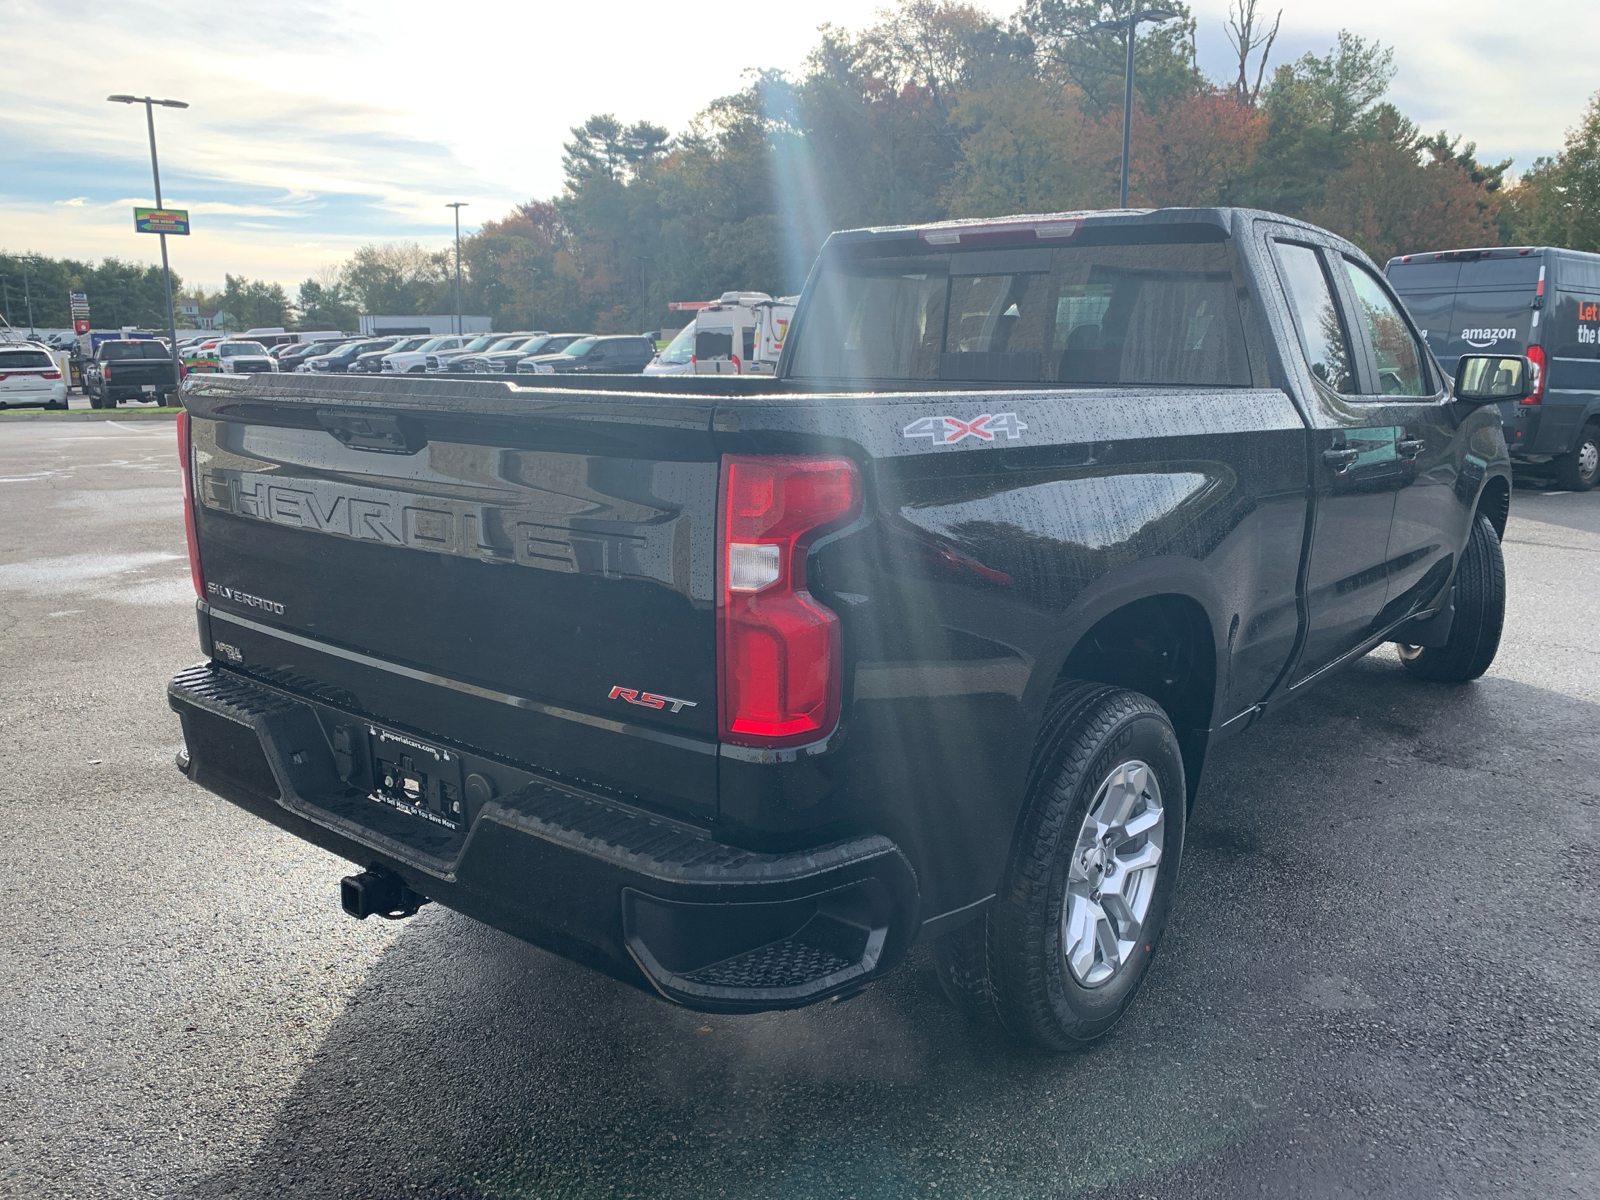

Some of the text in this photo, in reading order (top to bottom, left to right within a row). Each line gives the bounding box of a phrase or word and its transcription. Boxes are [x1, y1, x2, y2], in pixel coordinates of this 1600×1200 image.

[1579, 301, 1597, 321] Let
[1461, 328, 1517, 340] amazon
[1578, 324, 1596, 344] the
[202, 473, 649, 580] CHEVROLET
[207, 581, 286, 615] SILVERADO
[608, 685, 698, 713] RST
[1082, 727, 1133, 809] MICHELIN
